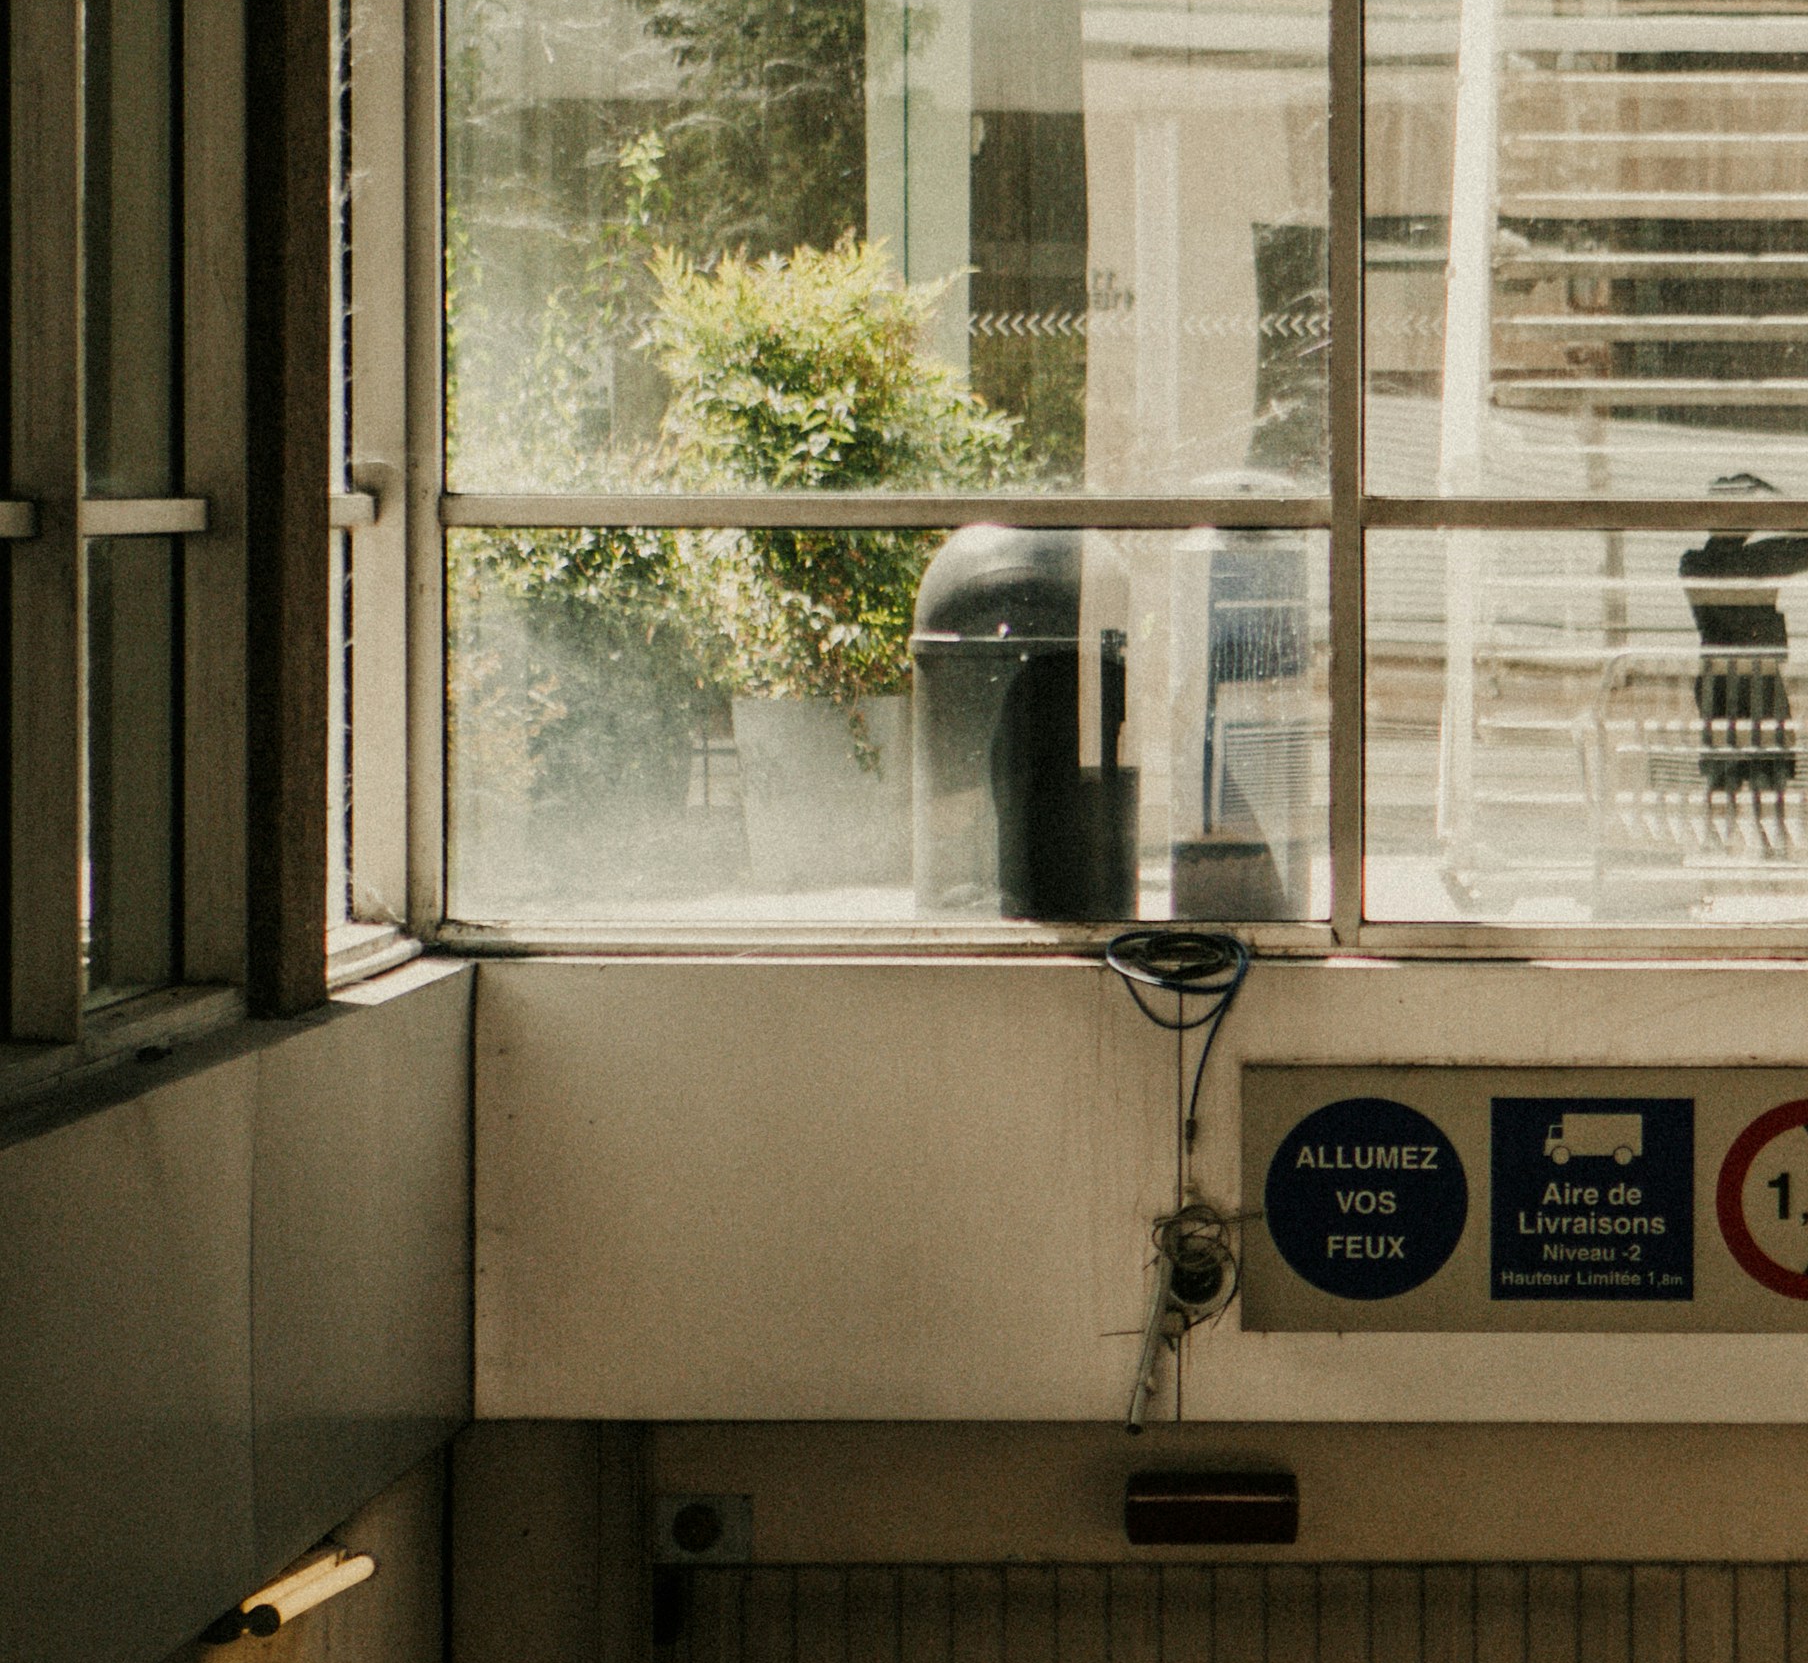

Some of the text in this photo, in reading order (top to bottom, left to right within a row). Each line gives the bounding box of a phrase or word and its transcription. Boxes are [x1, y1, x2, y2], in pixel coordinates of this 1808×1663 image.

[1296, 1146, 1438, 1170] ALLUMEZ
[1336, 1190, 1397, 1215] VOS
[1542, 1182, 1642, 1206] Aire de
[1518, 1211, 1667, 1235] Livraisons
[1327, 1235, 1406, 1259] FEUX
[1543, 1243, 1642, 1261] Niveau -2
[1501, 1270, 1571, 1286] Hauteur
[1576, 1269, 1641, 1286] Limitée
